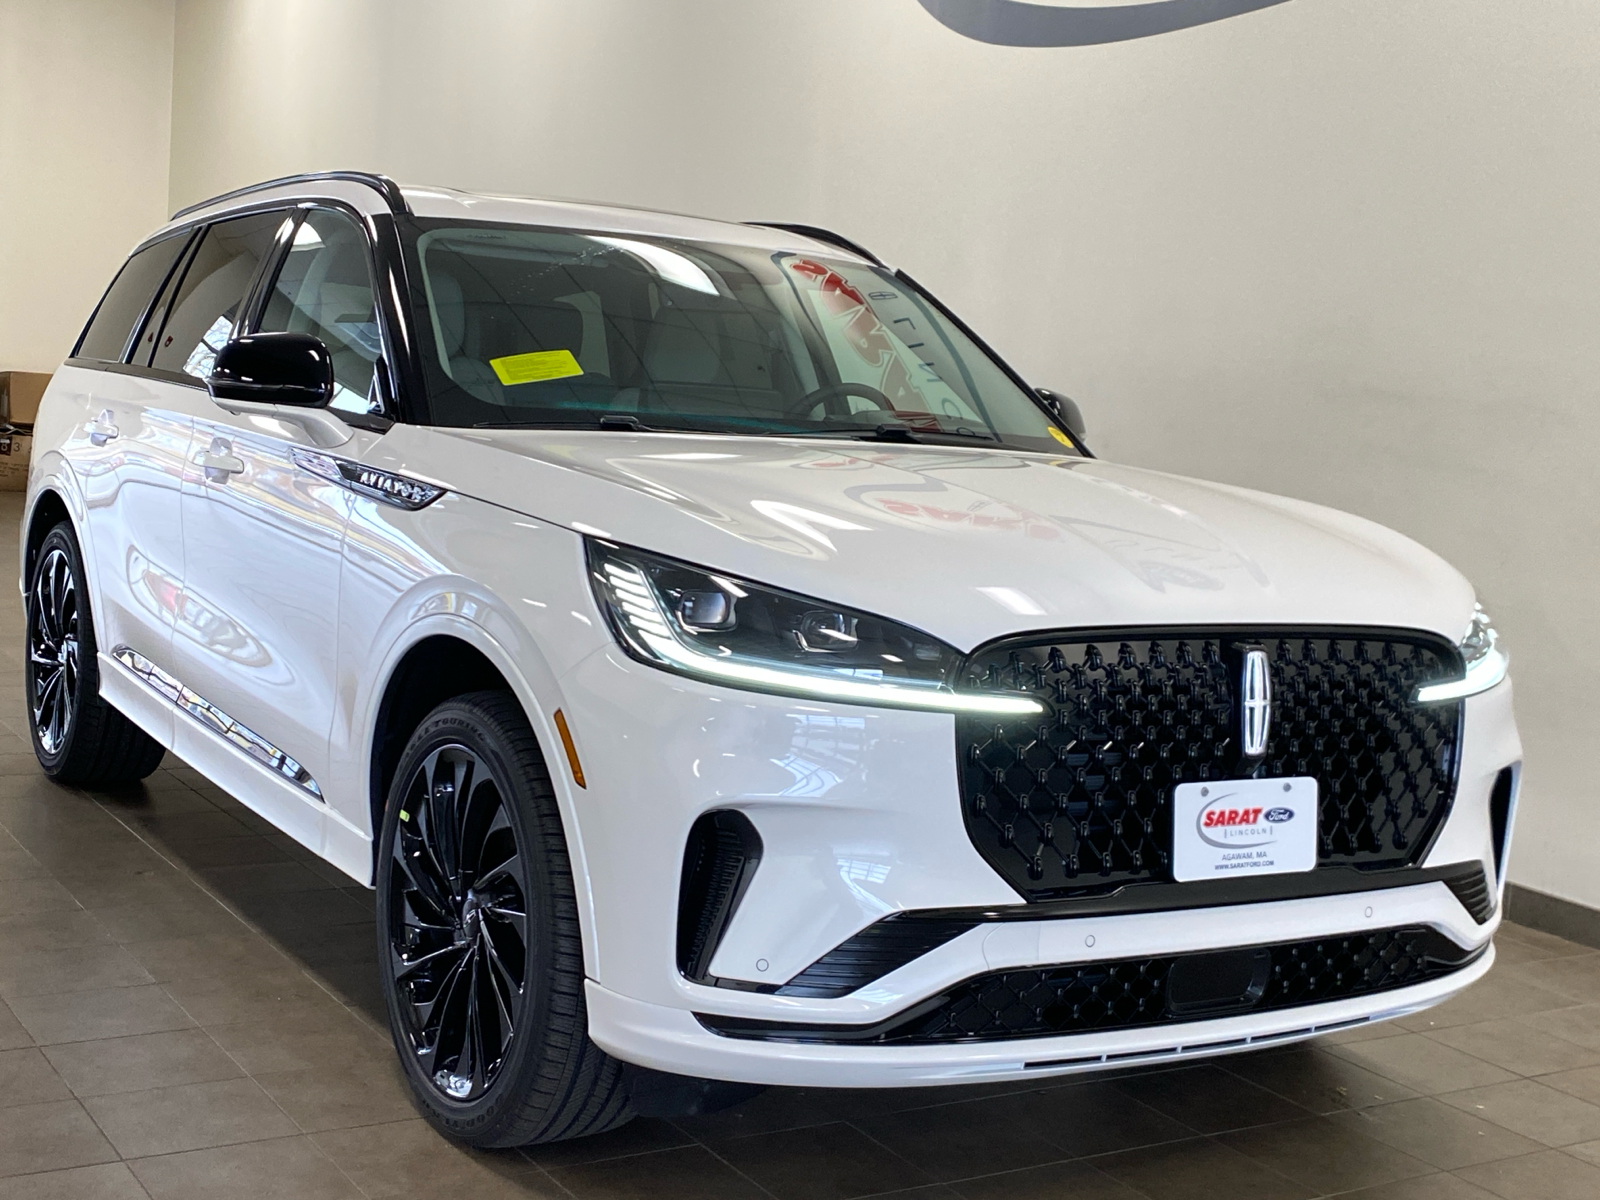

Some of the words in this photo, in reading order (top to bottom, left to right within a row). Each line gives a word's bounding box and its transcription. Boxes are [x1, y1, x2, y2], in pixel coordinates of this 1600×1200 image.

[1203, 807, 1263, 828] SARAT
[1267, 808, 1291, 822] Ford
[1230, 828, 1267, 836] LINCOLN
[1222, 852, 1254, 860] AGAWAM,
[1214, 860, 1273, 869] WWW.SARATFORD.COM
